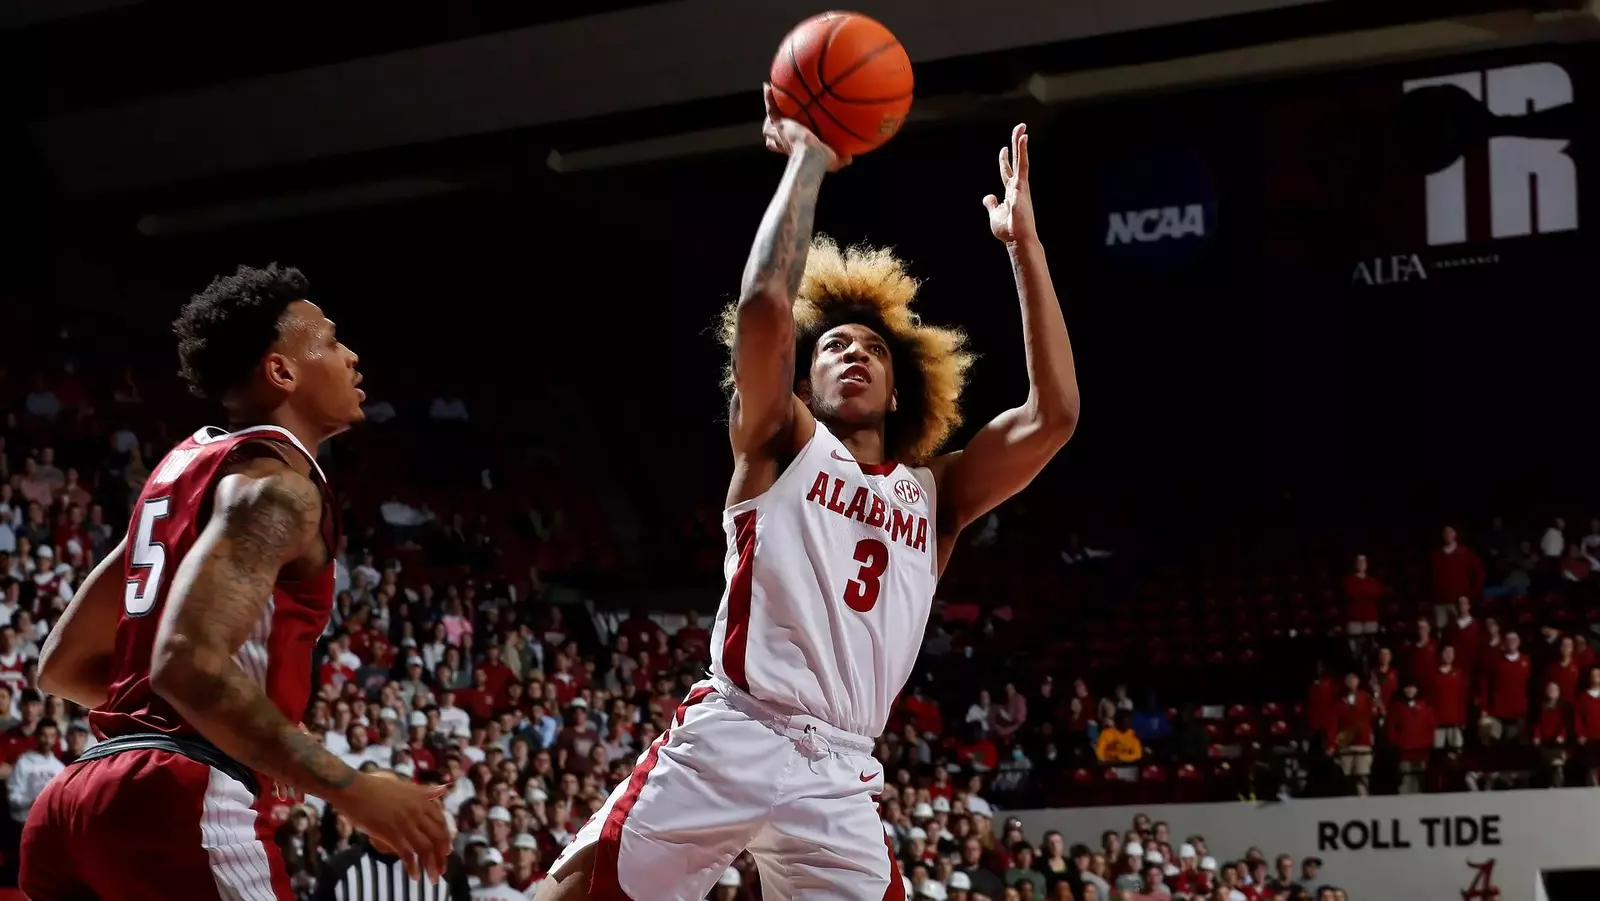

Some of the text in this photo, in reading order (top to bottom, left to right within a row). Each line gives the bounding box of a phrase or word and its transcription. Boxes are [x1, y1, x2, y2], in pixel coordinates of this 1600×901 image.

[1105, 203, 1205, 247] NCAA
[1351, 252, 1428, 288] ALFA
[894, 480, 920, 503] SEC
[124, 496, 171, 618] 5
[843, 538, 889, 613] 3
[1318, 815, 1502, 851] ROLL TIDE
